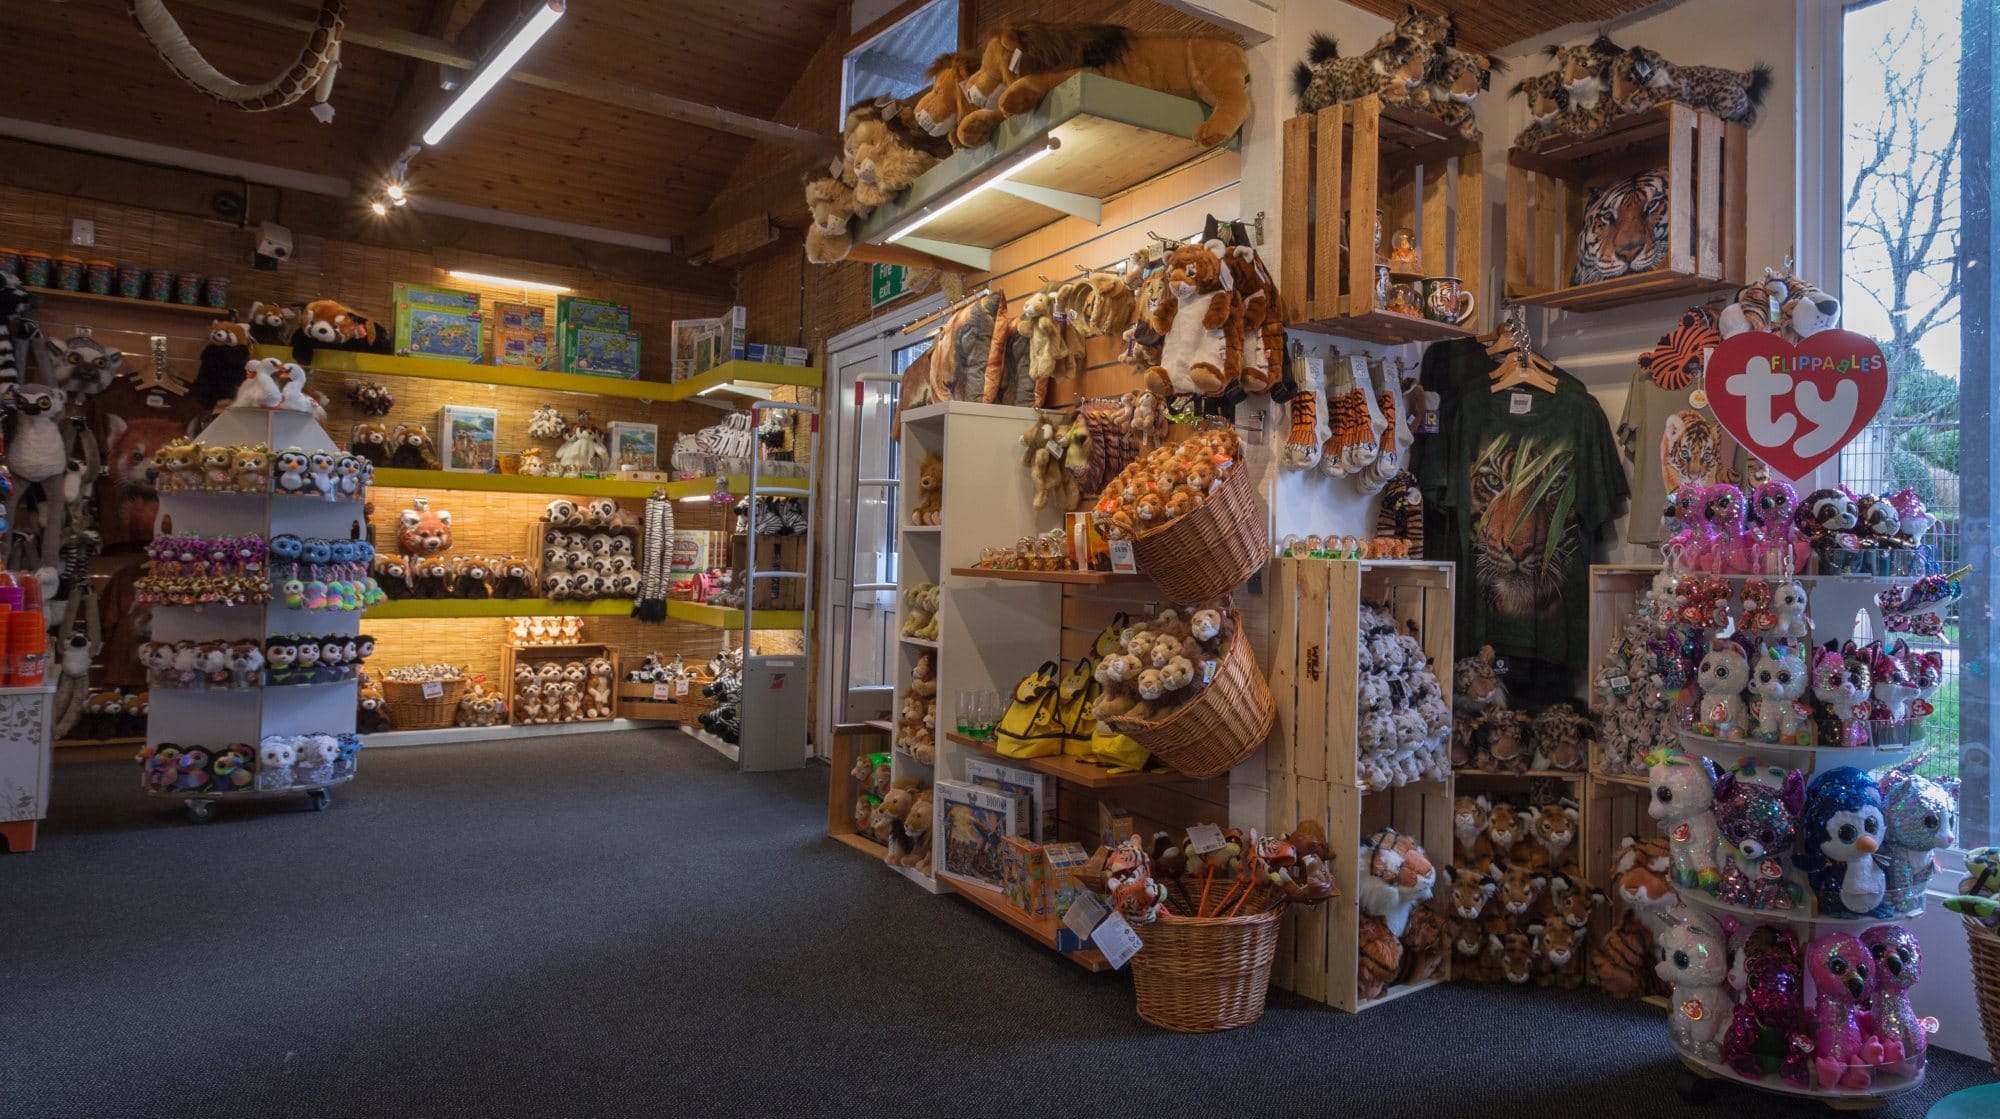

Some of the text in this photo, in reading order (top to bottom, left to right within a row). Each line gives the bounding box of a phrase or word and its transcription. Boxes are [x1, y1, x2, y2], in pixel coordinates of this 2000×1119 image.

[879, 264, 893, 280] Fire
[879, 280, 891, 299] exit
[1771, 355, 1882, 374] FLIPPABLES
[1725, 356, 1859, 458] ty
[1311, 645, 1320, 682] WILD
